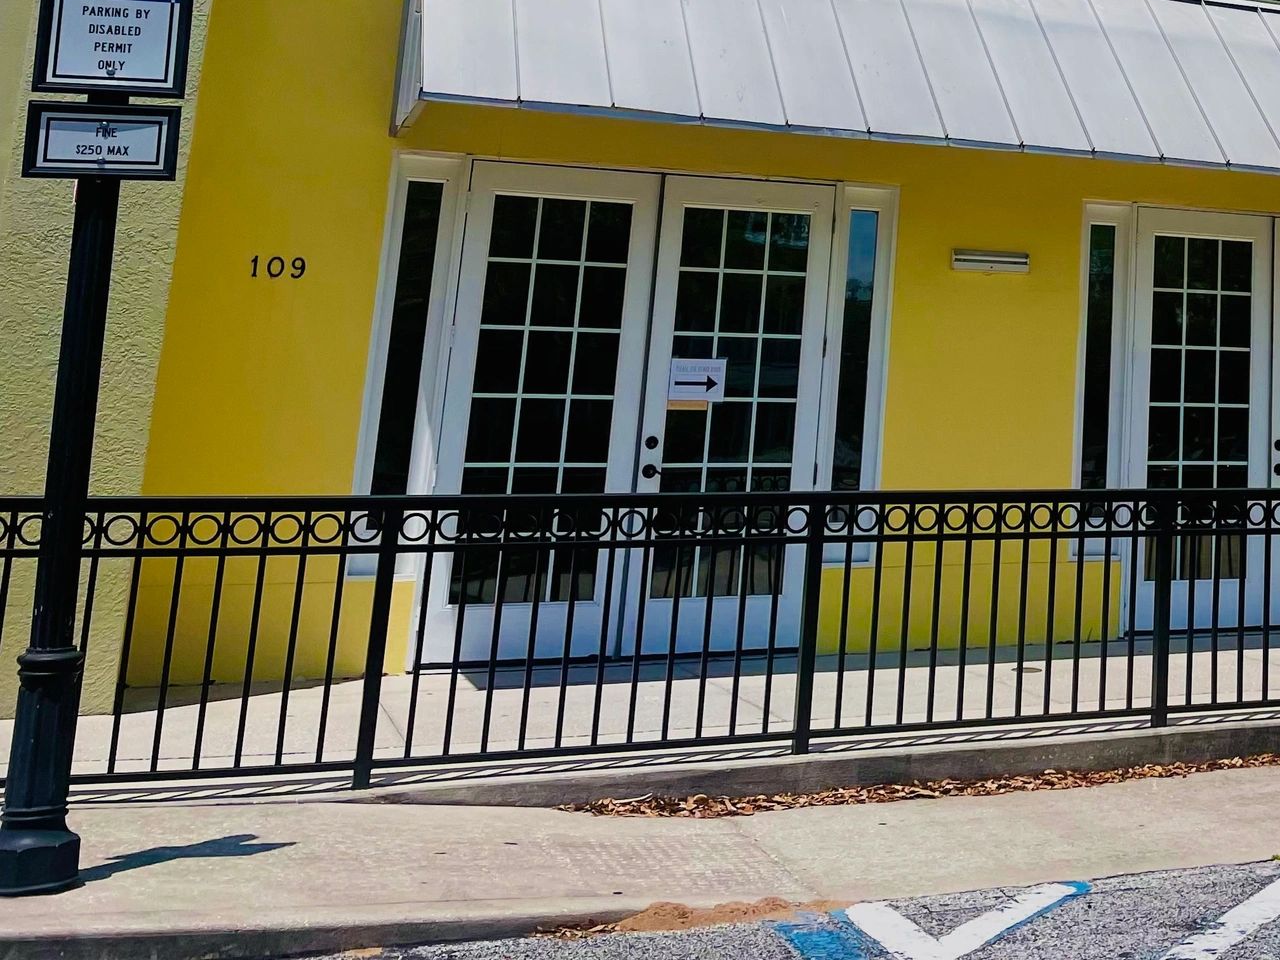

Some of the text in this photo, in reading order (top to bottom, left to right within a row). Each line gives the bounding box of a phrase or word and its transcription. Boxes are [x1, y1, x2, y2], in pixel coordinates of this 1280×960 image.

[82, 5, 151, 19] PARKING BY
[88, 23, 142, 36] DISABLED
[94, 41, 133, 53] PERMIT
[98, 60, 125, 71] ONLY
[95, 127, 118, 138] FINE
[75, 144, 130, 156] $250 MAX
[250, 255, 306, 279] 109
